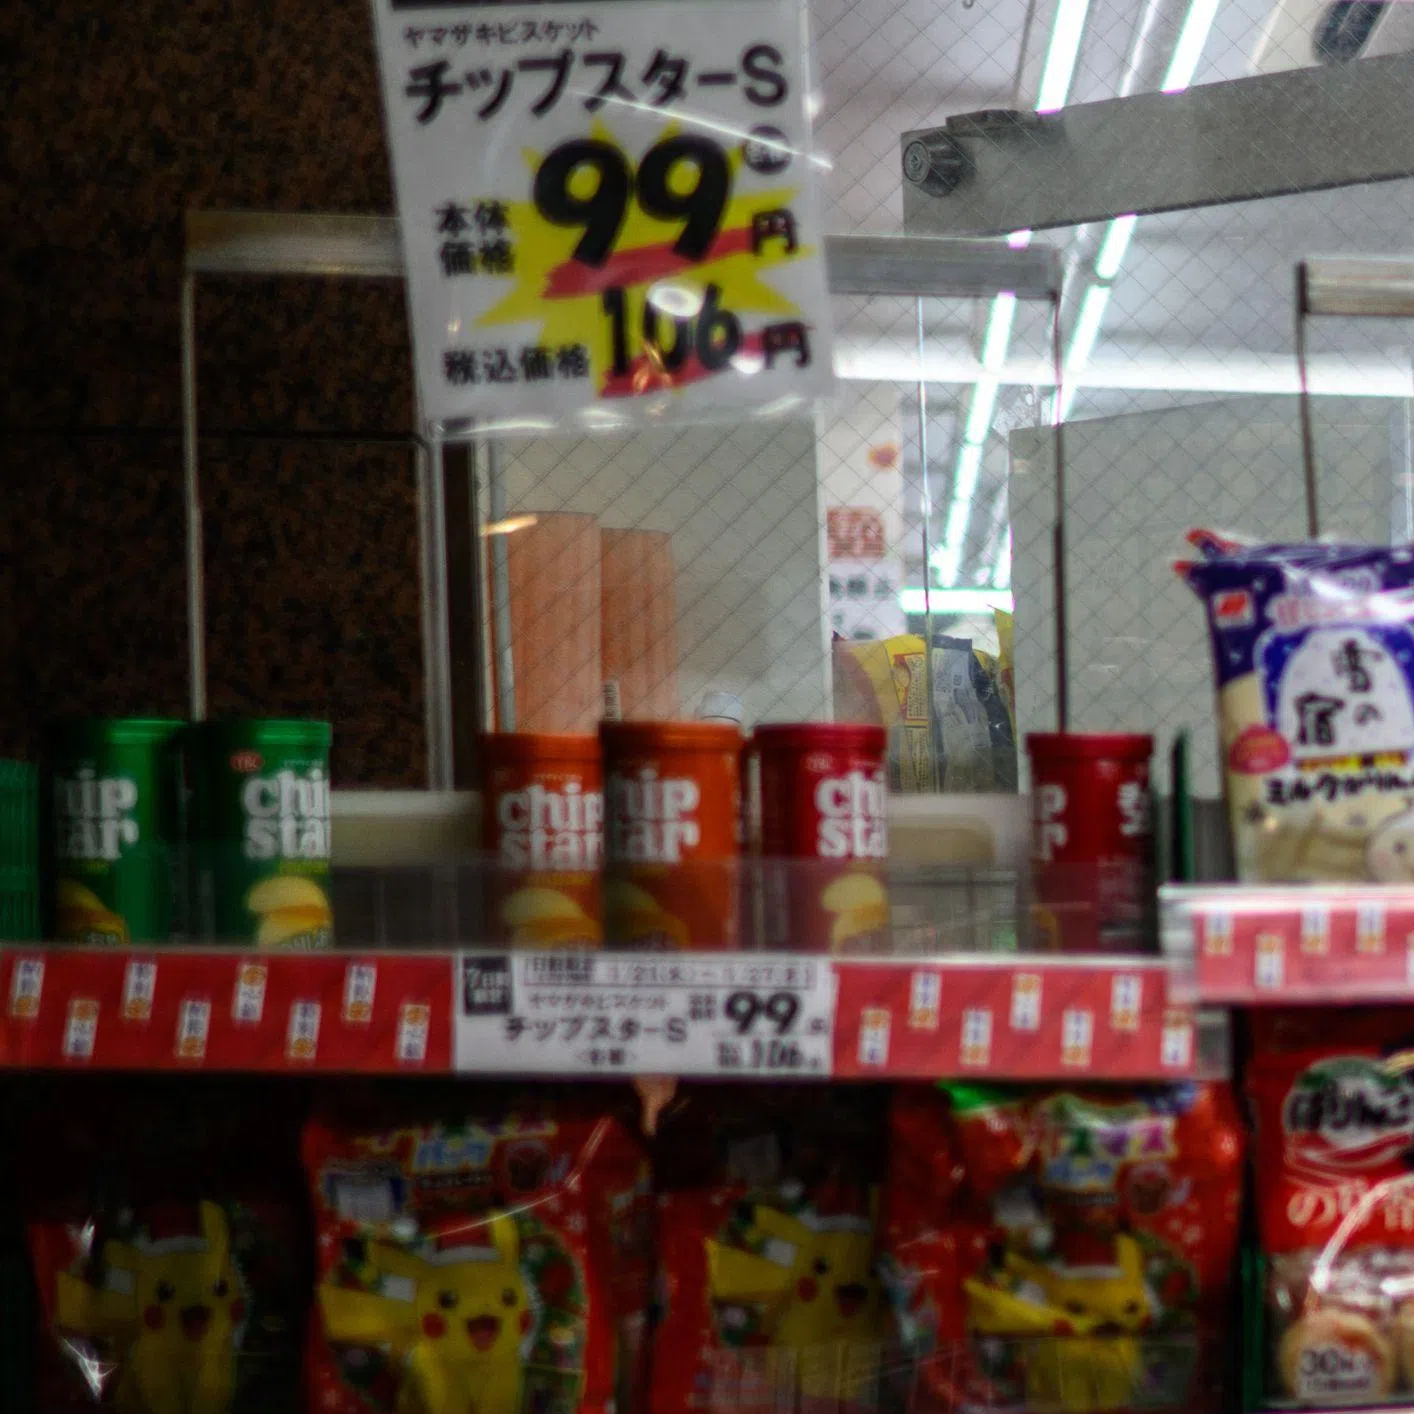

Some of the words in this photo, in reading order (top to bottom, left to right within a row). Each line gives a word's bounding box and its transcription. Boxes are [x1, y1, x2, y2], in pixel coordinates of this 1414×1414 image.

[405, 20, 599, 46] ヤマザキビスケット
[405, 44, 789, 125] チップスターS
